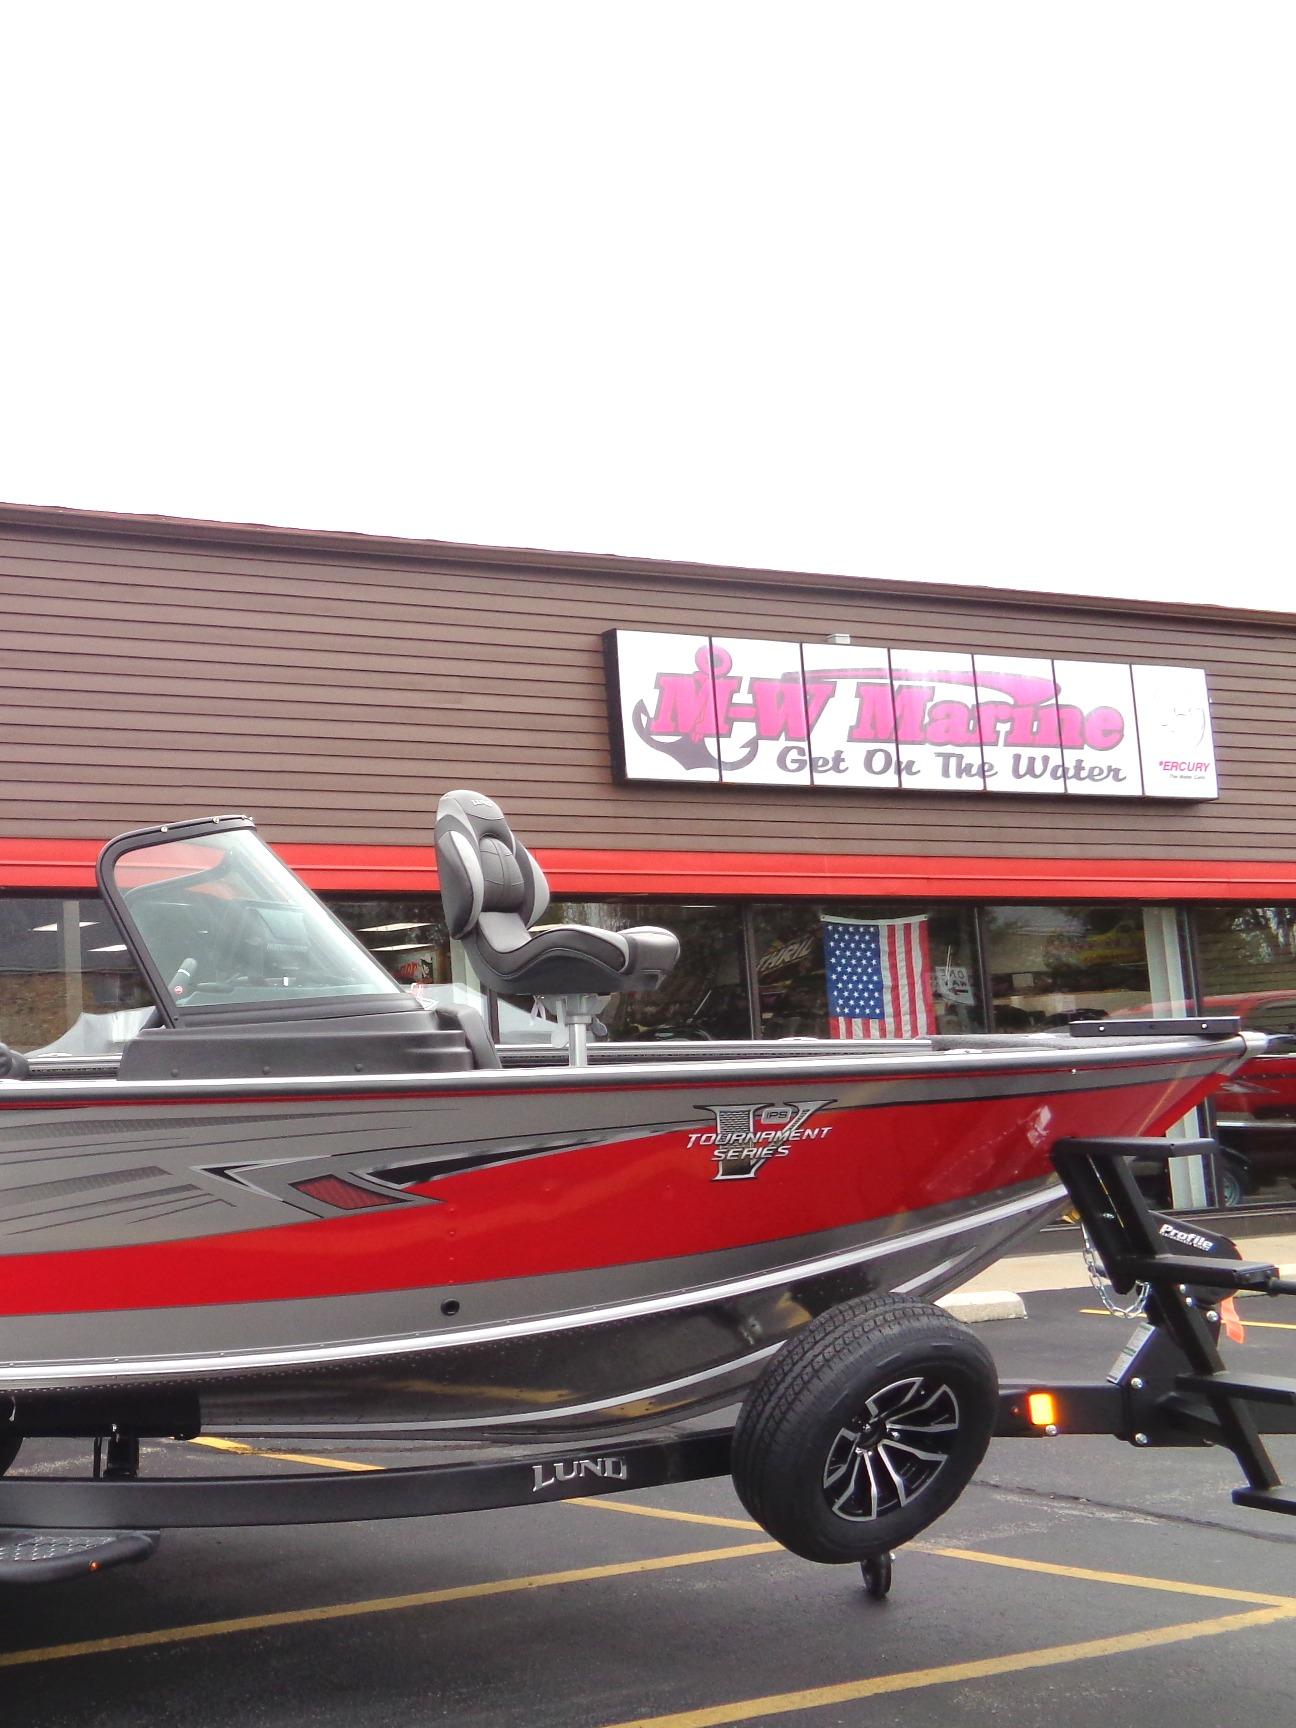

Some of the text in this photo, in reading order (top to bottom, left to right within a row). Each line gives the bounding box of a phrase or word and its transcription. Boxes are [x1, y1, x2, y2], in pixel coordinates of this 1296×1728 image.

[650, 671, 1125, 752] M-W Marine
[776, 745, 1127, 783] Get On The Water
[1159, 761, 1210, 772] ERCURY
[687, 1127, 833, 1149] TOURNAMENT
[711, 1145, 792, 1162] SERIES
[1159, 1223, 1214, 1251] Profile
[532, 1457, 628, 1492] LUND
